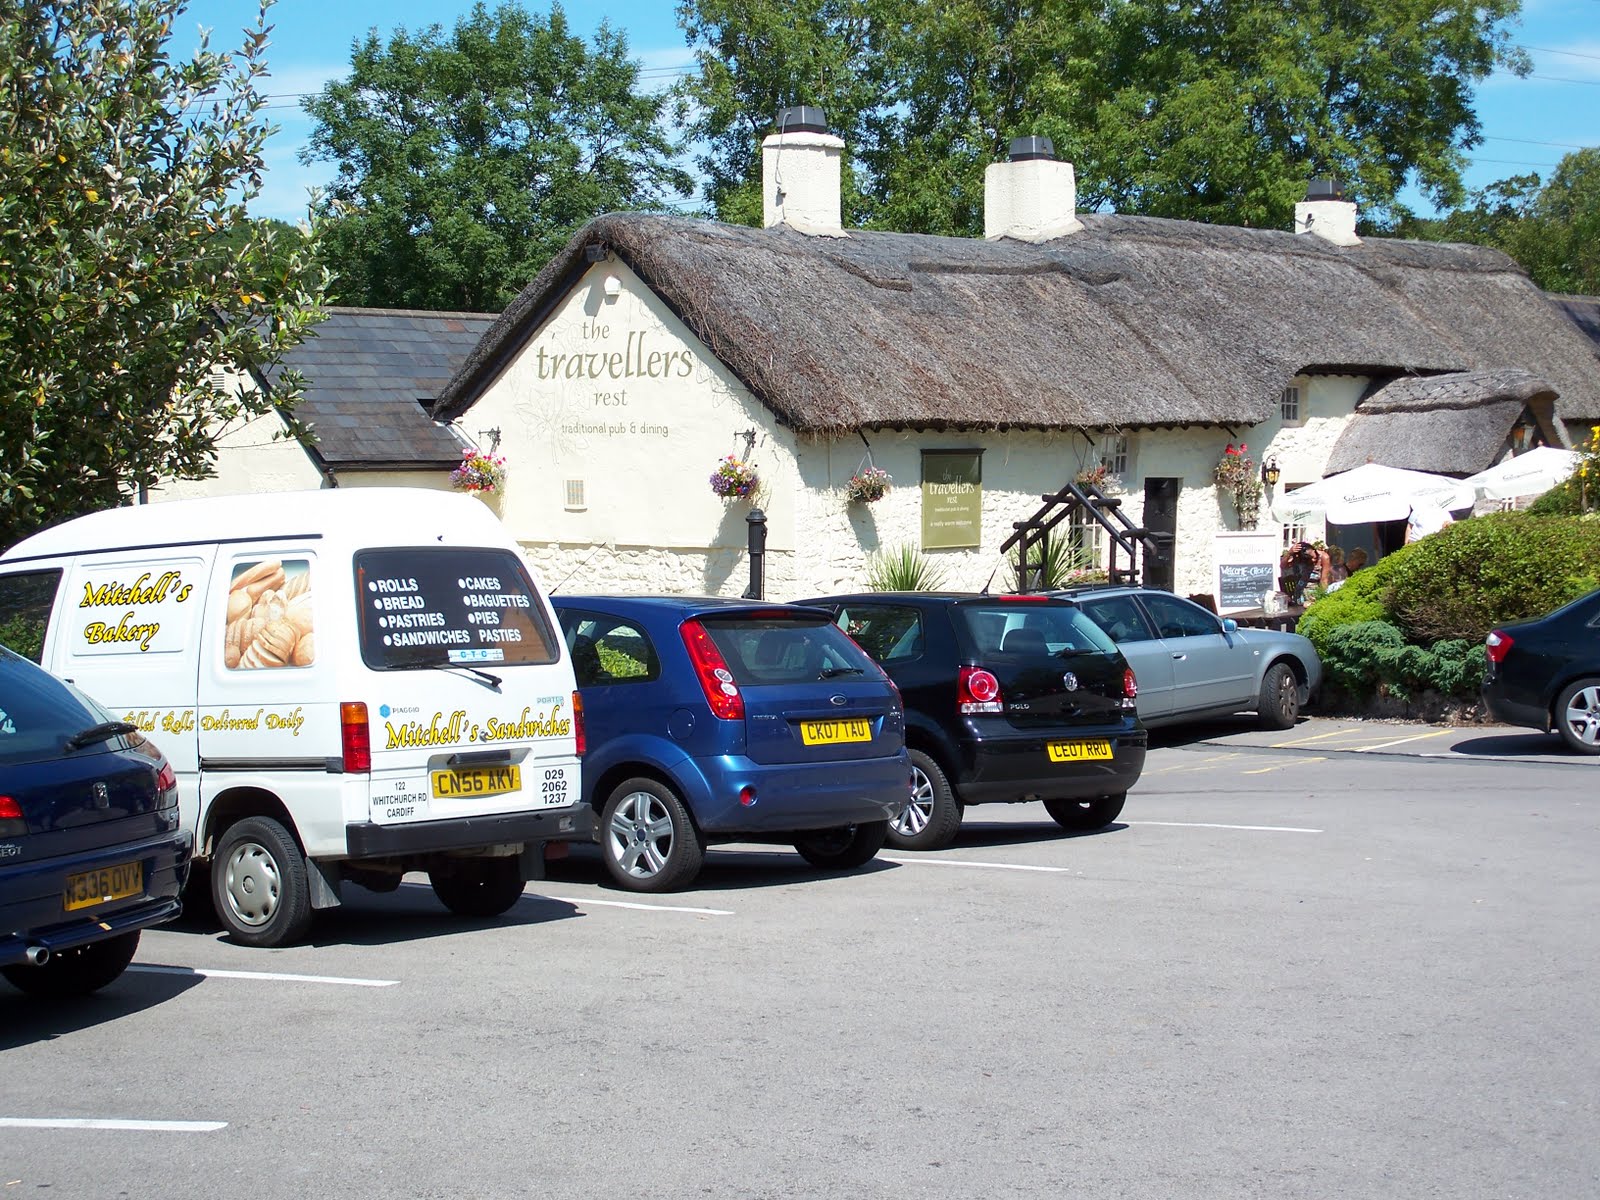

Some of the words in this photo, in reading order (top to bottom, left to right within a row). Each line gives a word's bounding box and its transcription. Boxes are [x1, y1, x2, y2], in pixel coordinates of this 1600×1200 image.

[582, 317, 610, 343] the
[536, 331, 693, 380] travellers
[593, 389, 628, 406] rest
[561, 421, 607, 434] traditional
[609, 421, 626, 437] pub
[629, 421, 636, 434] &
[640, 421, 669, 438] dining
[929, 475, 975, 495] travellers
[946, 495, 958, 504] rest
[79, 571, 193, 608] Mitchell's
[377, 577, 419, 593] ROLLS
[465, 577, 501, 590] CAKES
[382, 595, 425, 610] BREAD
[471, 594, 530, 608] BAGUETTES
[387, 613, 445, 628] PASTRIES
[474, 612, 500, 625] PIES
[84, 612, 160, 652] Bakery
[393, 630, 470, 647] SANDWICHES
[479, 629, 521, 643] PASTIES
[392, 706, 420, 714] PIAGGIO
[161, 710, 195, 735] Rolls
[200, 709, 264, 731] Delivered
[265, 706, 304, 736] Daily
[385, 711, 479, 750] Mitchell's
[486, 705, 571, 741] Sandwiches
[807, 722, 839, 740] CK07
[844, 720, 865, 738] TAU
[1053, 743, 1083, 758] CE07
[1087, 741, 1108, 756] RRU
[438, 771, 483, 795] CN56
[488, 767, 515, 790] AKV
[544, 769, 564, 781] 029
[395, 781, 406, 791] 122
[542, 781, 567, 793] 2062
[372, 793, 417, 806] WHITCHURCH
[418, 792, 428, 802] RD
[543, 793, 567, 805] 1237
[387, 806, 415, 818] CARDIFF
